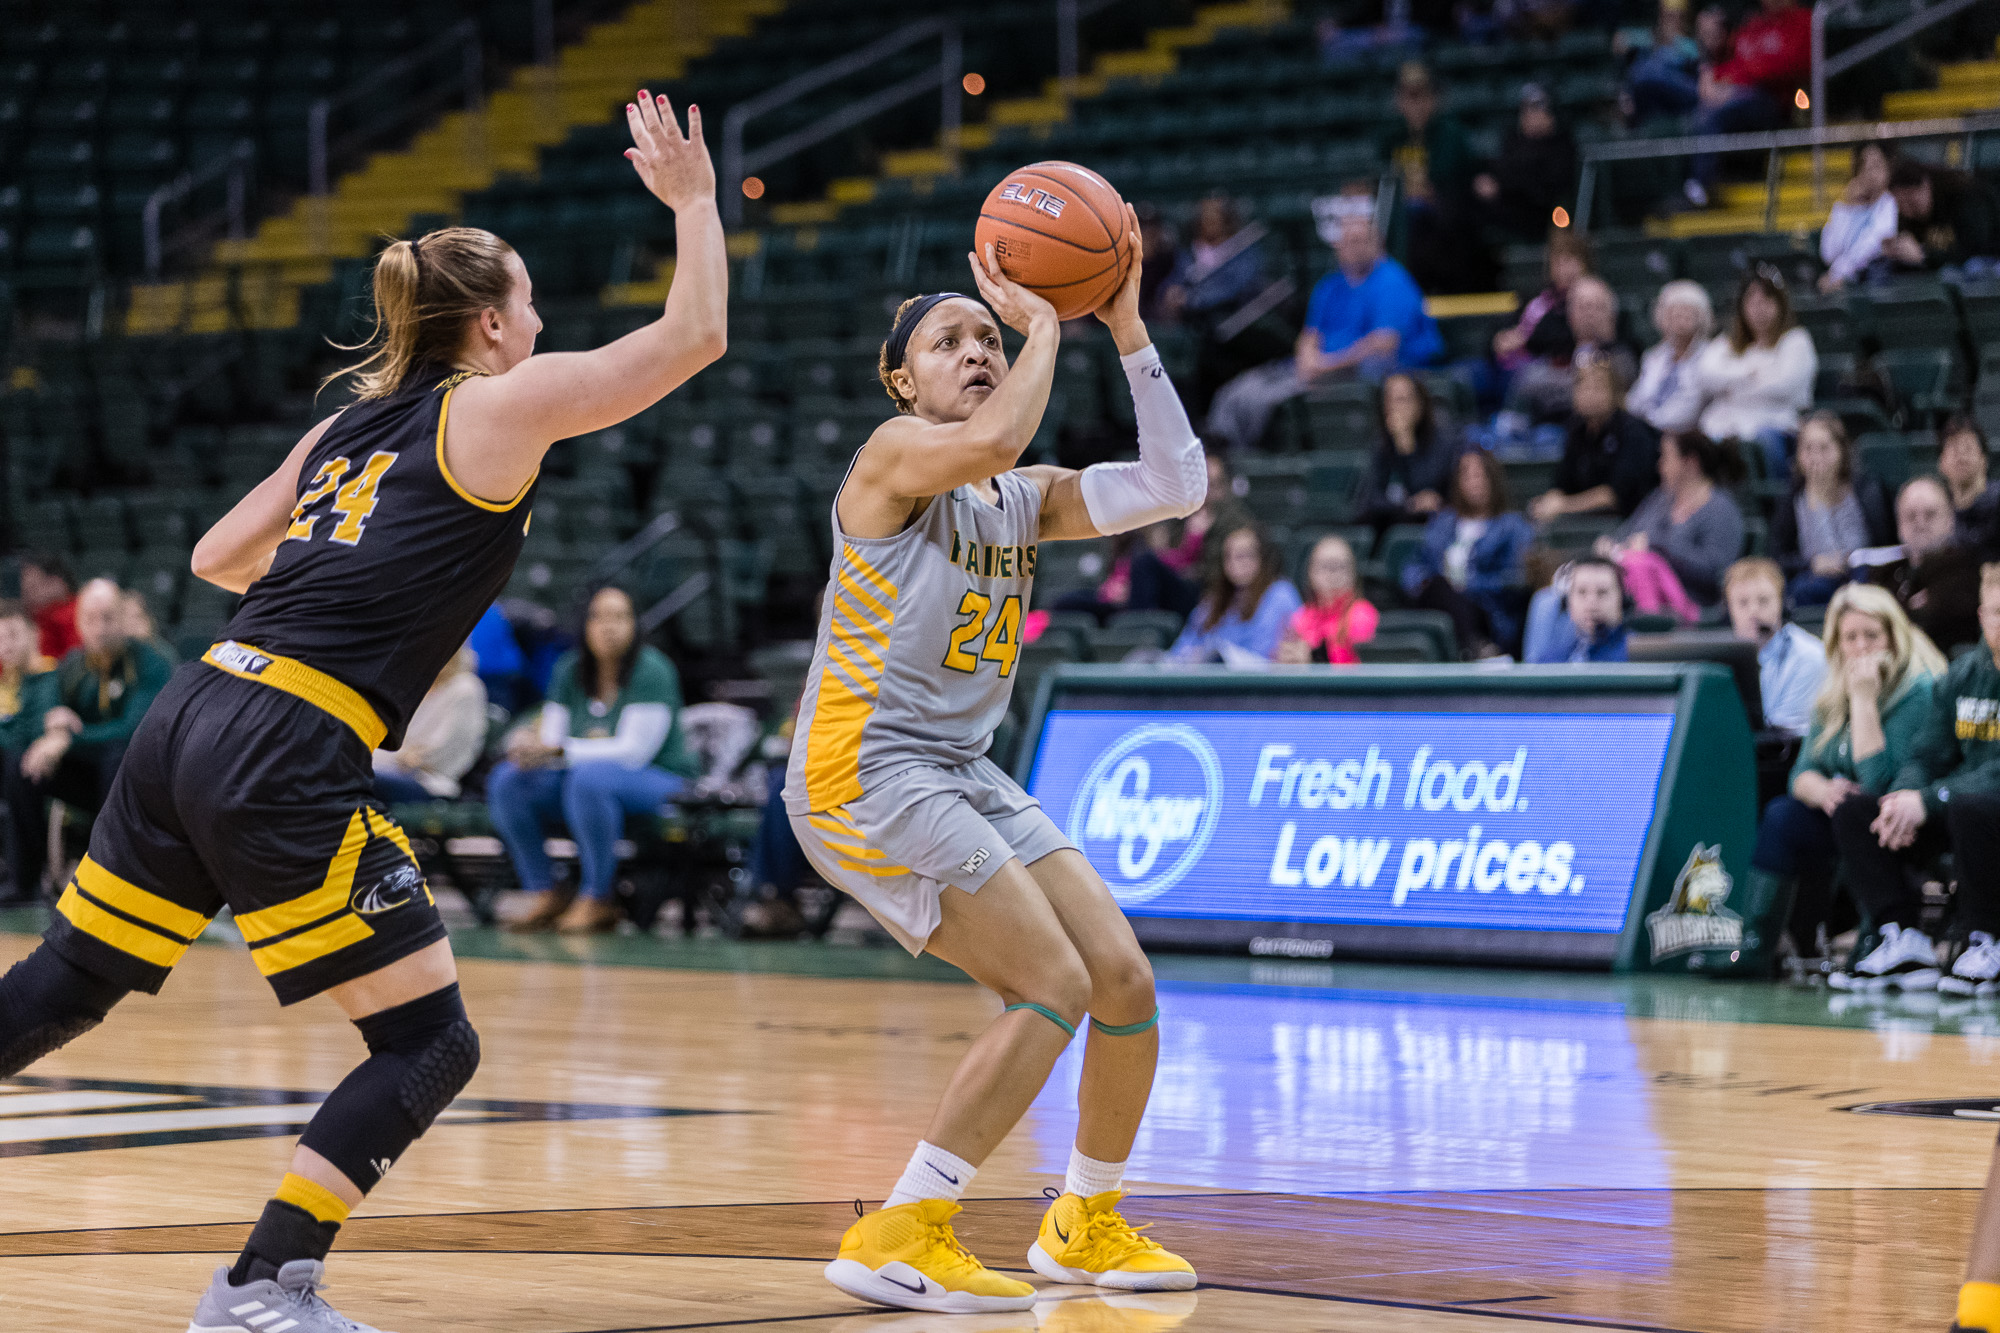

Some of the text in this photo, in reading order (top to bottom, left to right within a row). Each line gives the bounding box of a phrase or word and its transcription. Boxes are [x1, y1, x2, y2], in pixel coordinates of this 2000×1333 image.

[999, 182, 1067, 218] ELITE
[286, 450, 399, 546] 24
[941, 588, 1022, 678] 24
[1250, 744, 1528, 812] Fresh food.
[959, 847, 991, 876] WSU
[1270, 821, 1585, 906] Low prices.
